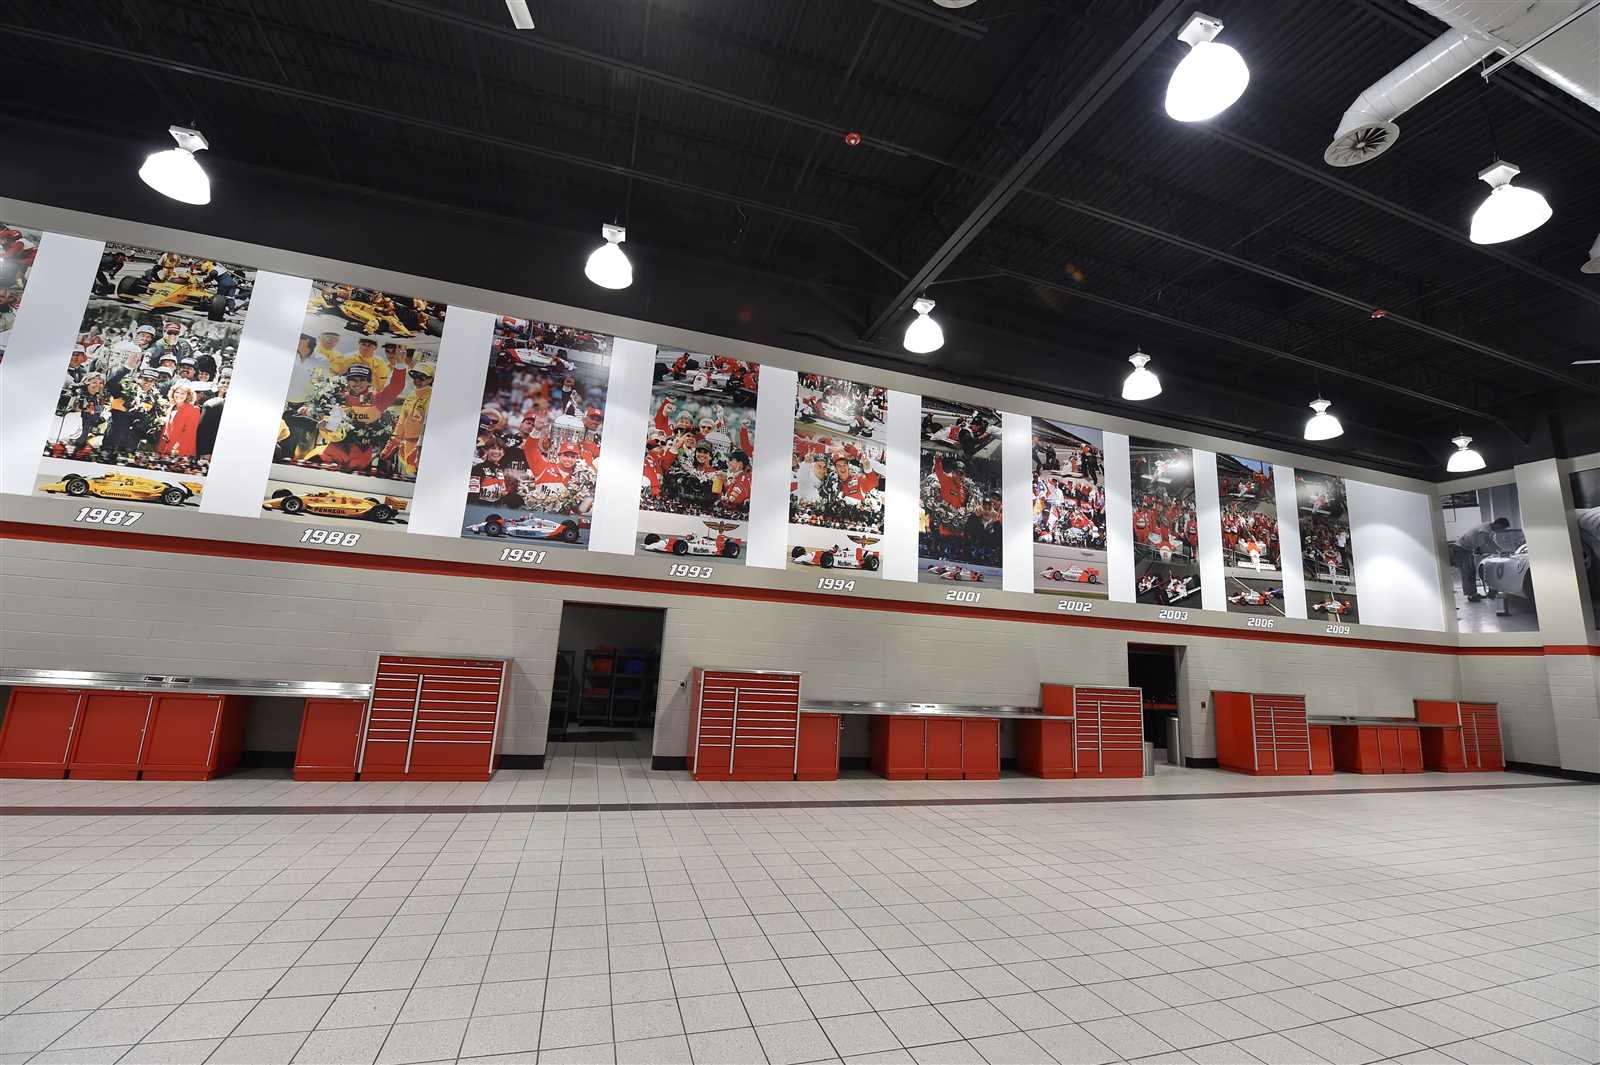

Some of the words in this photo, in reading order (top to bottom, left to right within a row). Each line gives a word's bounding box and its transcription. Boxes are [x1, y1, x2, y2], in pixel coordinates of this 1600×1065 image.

[125, 478, 134, 486] 25
[74, 506, 144, 527] 1987
[300, 528, 361, 547] 1988
[500, 548, 547, 564] 1991
[668, 564, 714, 579] 1993
[817, 577, 856, 592] 1994
[945, 590, 981, 602] 2001
[1057, 600, 1092, 612] 2002
[1159, 609, 1189, 620] 2003
[1247, 618, 1274, 628] 2006
[1326, 624, 1351, 634] 2009
